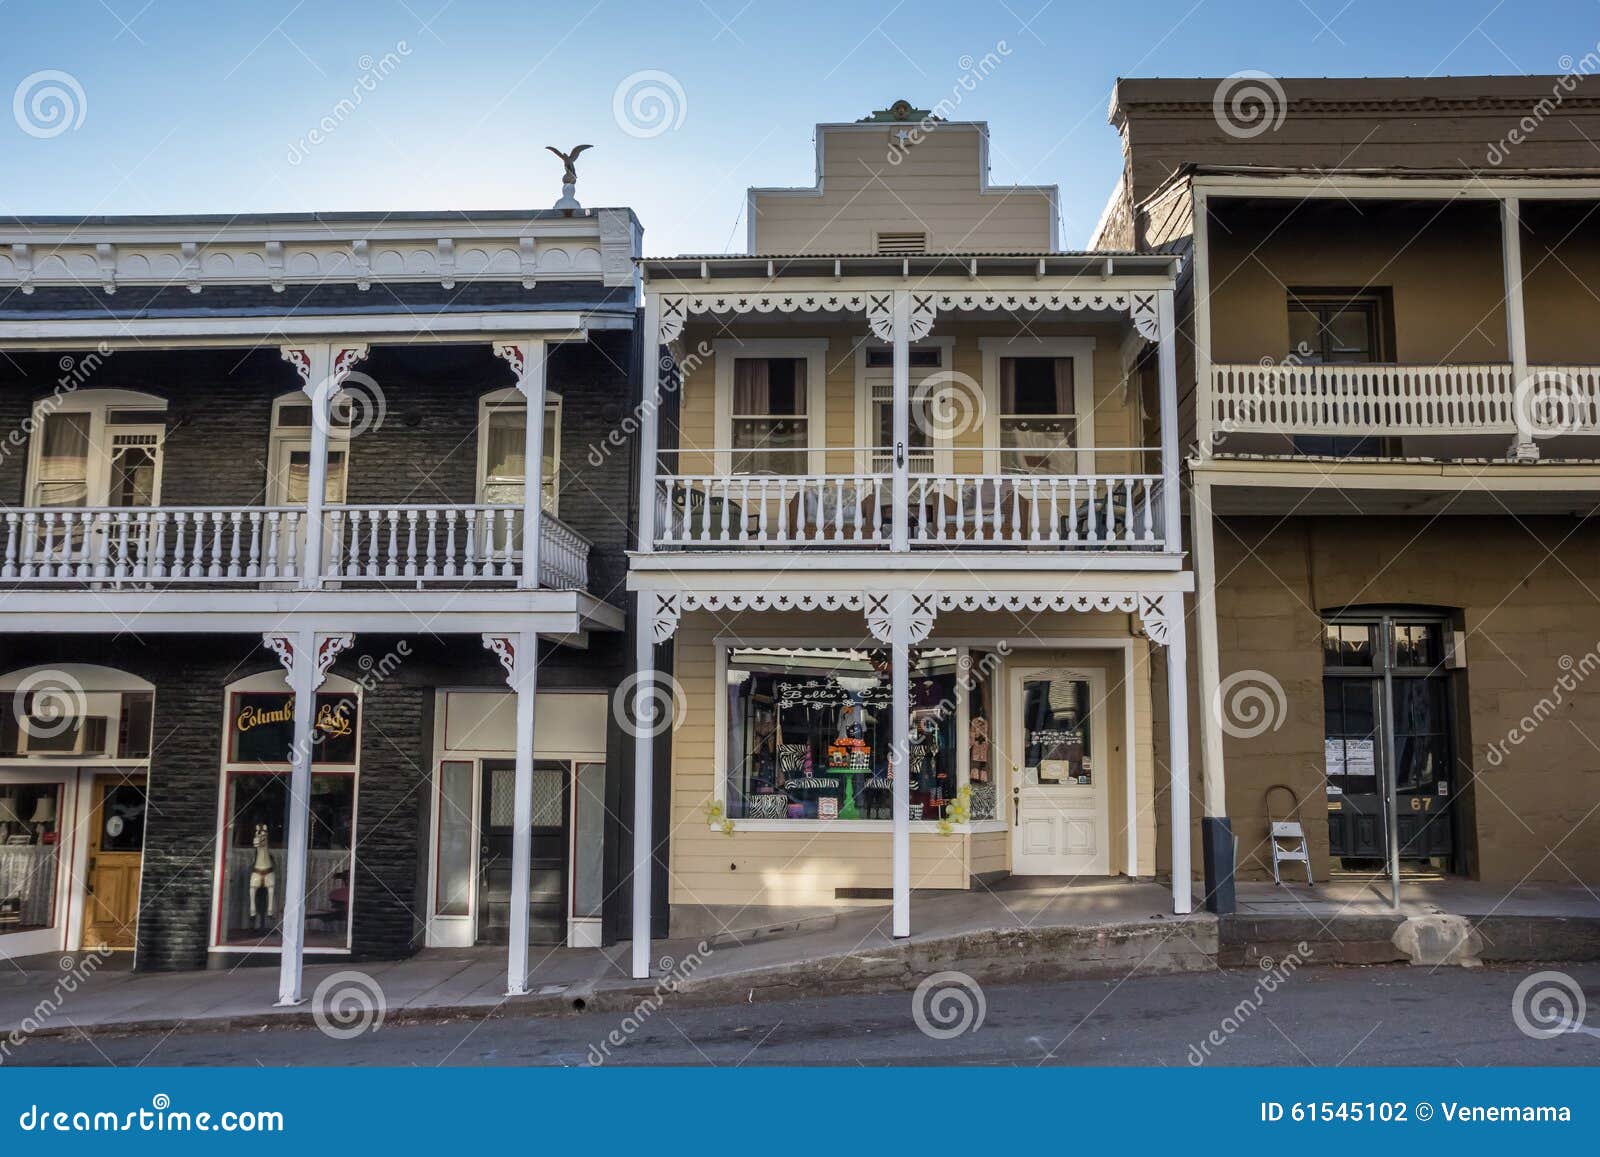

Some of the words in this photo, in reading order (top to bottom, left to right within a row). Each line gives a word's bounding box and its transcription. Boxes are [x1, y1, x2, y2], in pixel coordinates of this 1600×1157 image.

[782, 690, 848, 699] Bella's
[315, 704, 353, 738] Lady
[1411, 797, 1431, 811] 67
